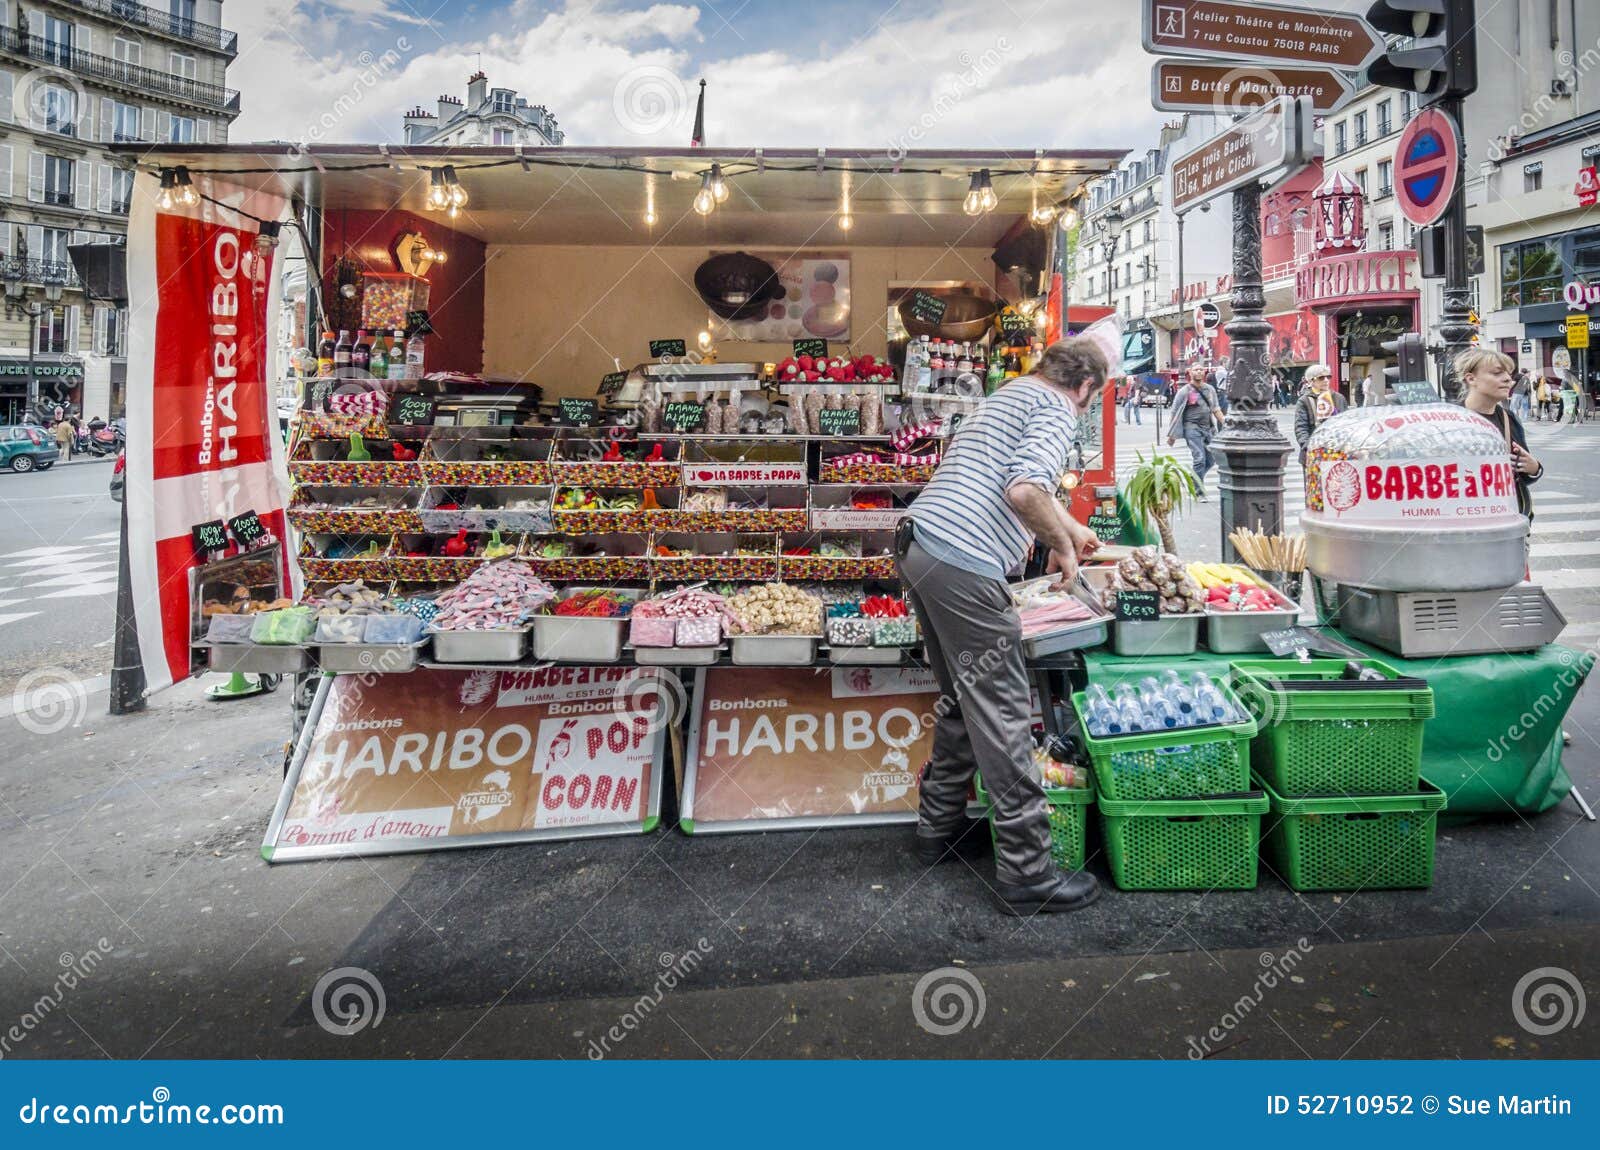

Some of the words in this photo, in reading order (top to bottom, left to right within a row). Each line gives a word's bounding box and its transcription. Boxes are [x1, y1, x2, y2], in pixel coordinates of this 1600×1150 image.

[1193, 10, 1230, 24] Atelier
[1235, 15, 1273, 29] Théâtre
[1277, 19, 1290, 31] de
[1294, 21, 1354, 38] Montmartre
[1193, 29, 1200, 40] 7
[1203, 33, 1221, 42] rue
[1225, 33, 1269, 47] Coustou
[1274, 38, 1305, 51] 75018
[1309, 42, 1340, 55] PARIS
[1191, 79, 1230, 92] Butte
[1238, 80, 1323, 96] Montmartre
[1187, 163, 1200, 177] Les
[1202, 148, 1221, 168] trois
[1202, 172, 1212, 187] Bd
[1215, 168, 1225, 181] de
[1228, 152, 1257, 174] Clichy
[1318, 255, 1418, 298] ROUGE
[212, 232, 239, 462] HARIBO
[34, 366, 81, 376] COFFEE
[199, 376, 214, 465] Bonbons
[714, 470, 726, 481] LA
[728, 470, 762, 481] BARBE
[771, 470, 801, 481] PAPA
[1365, 463, 1459, 501] BARBE
[1465, 470, 1478, 498] à
[1480, 463, 1516, 497] PAP
[548, 700, 626, 716] Bonbons
[709, 697, 788, 712] Bonbons
[586, 716, 649, 760] POP
[704, 707, 921, 757] HARIBO
[308, 723, 532, 781] HARIBO
[542, 773, 638, 813] CORN
[867, 773, 911, 788] HARIBO
[463, 793, 508, 808] HARIBO
[283, 824, 357, 846] Pomme
[362, 815, 447, 840] d'amour
